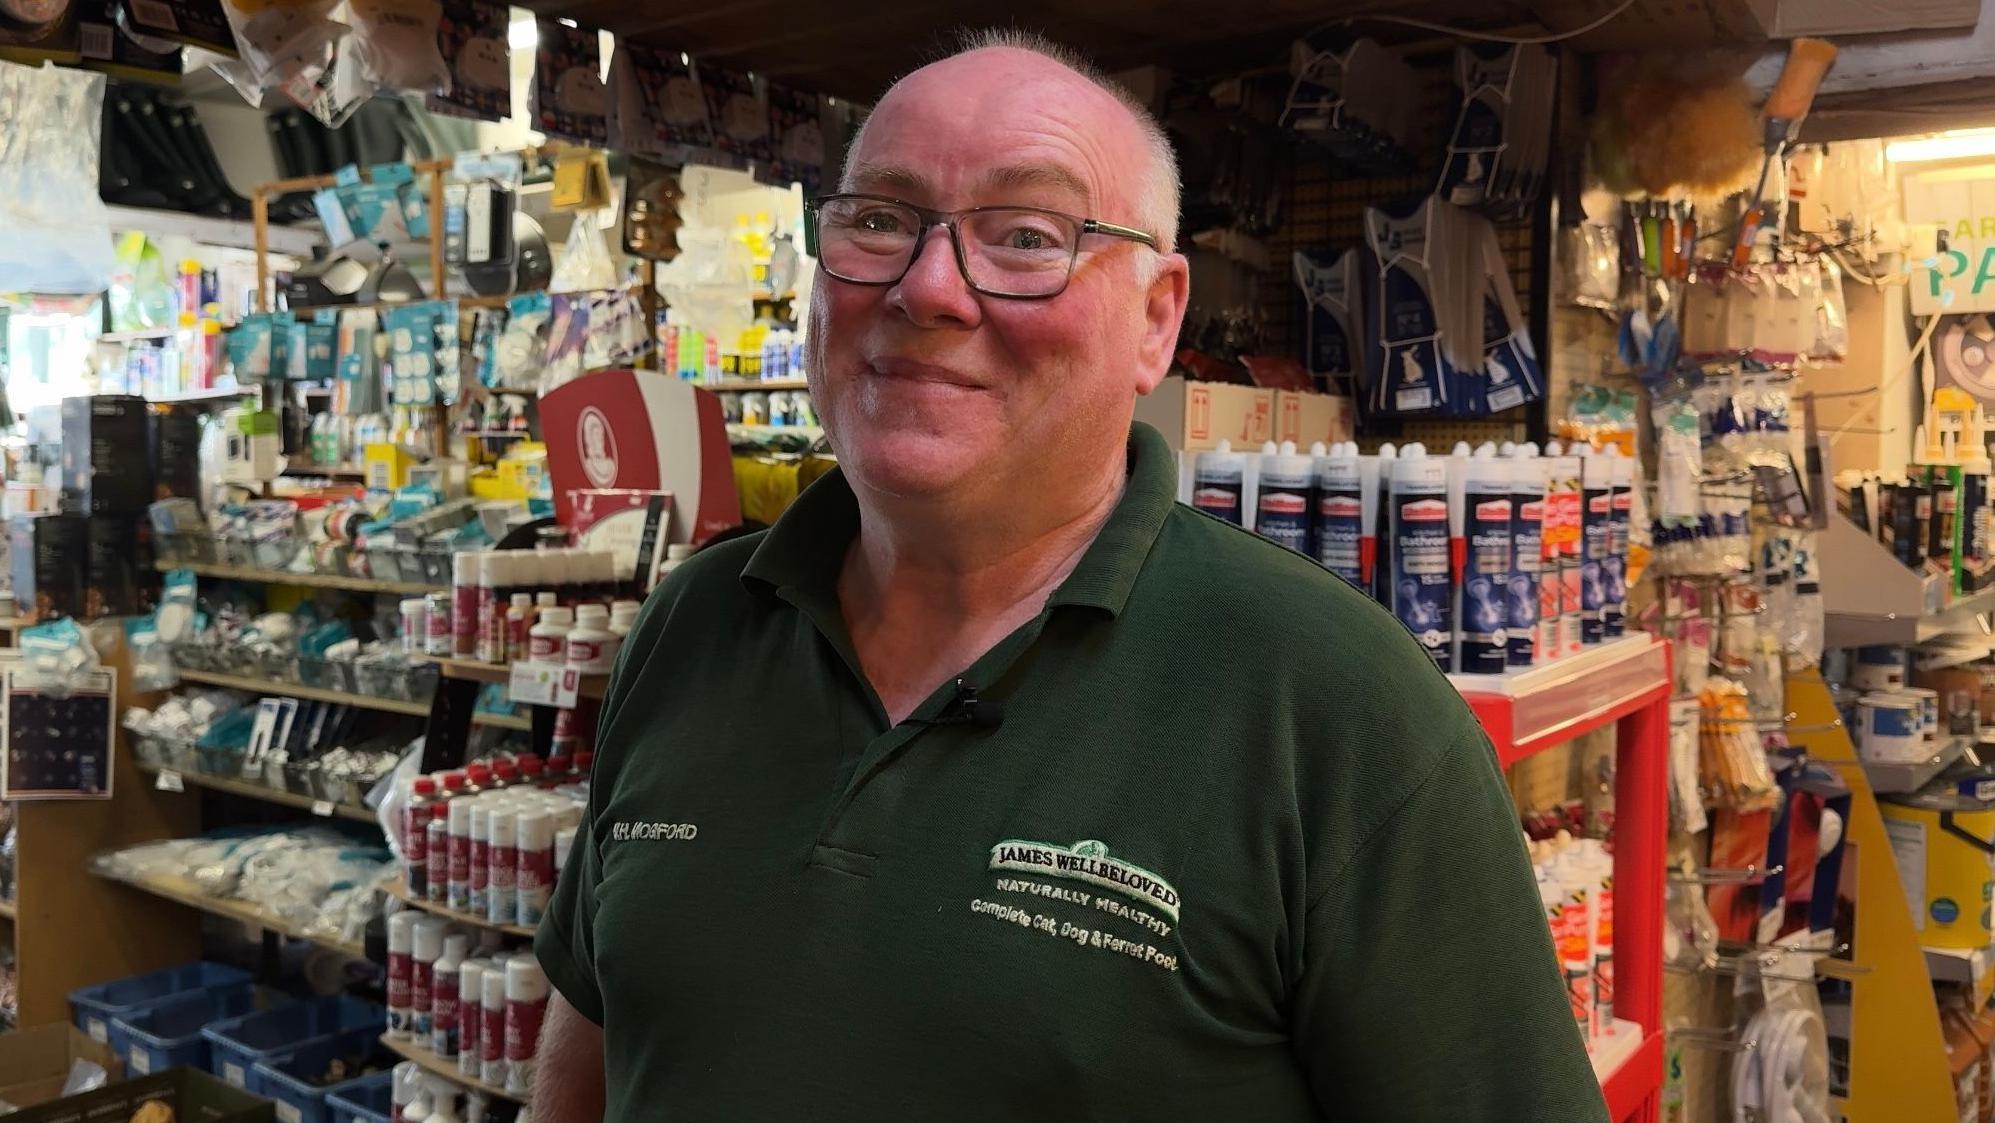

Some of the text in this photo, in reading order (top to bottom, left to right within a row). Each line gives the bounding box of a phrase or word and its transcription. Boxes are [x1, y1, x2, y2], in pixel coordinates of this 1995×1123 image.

[998, 847, 1178, 907] JAMES WELLBELOVED
[970, 898, 1032, 928] Complete
[1032, 914, 1057, 936] Cat,
[1060, 922, 1089, 946] Dog
[1101, 933, 1144, 959] Ferret
[996, 878, 1172, 937] NATURALLY HEALTHY
